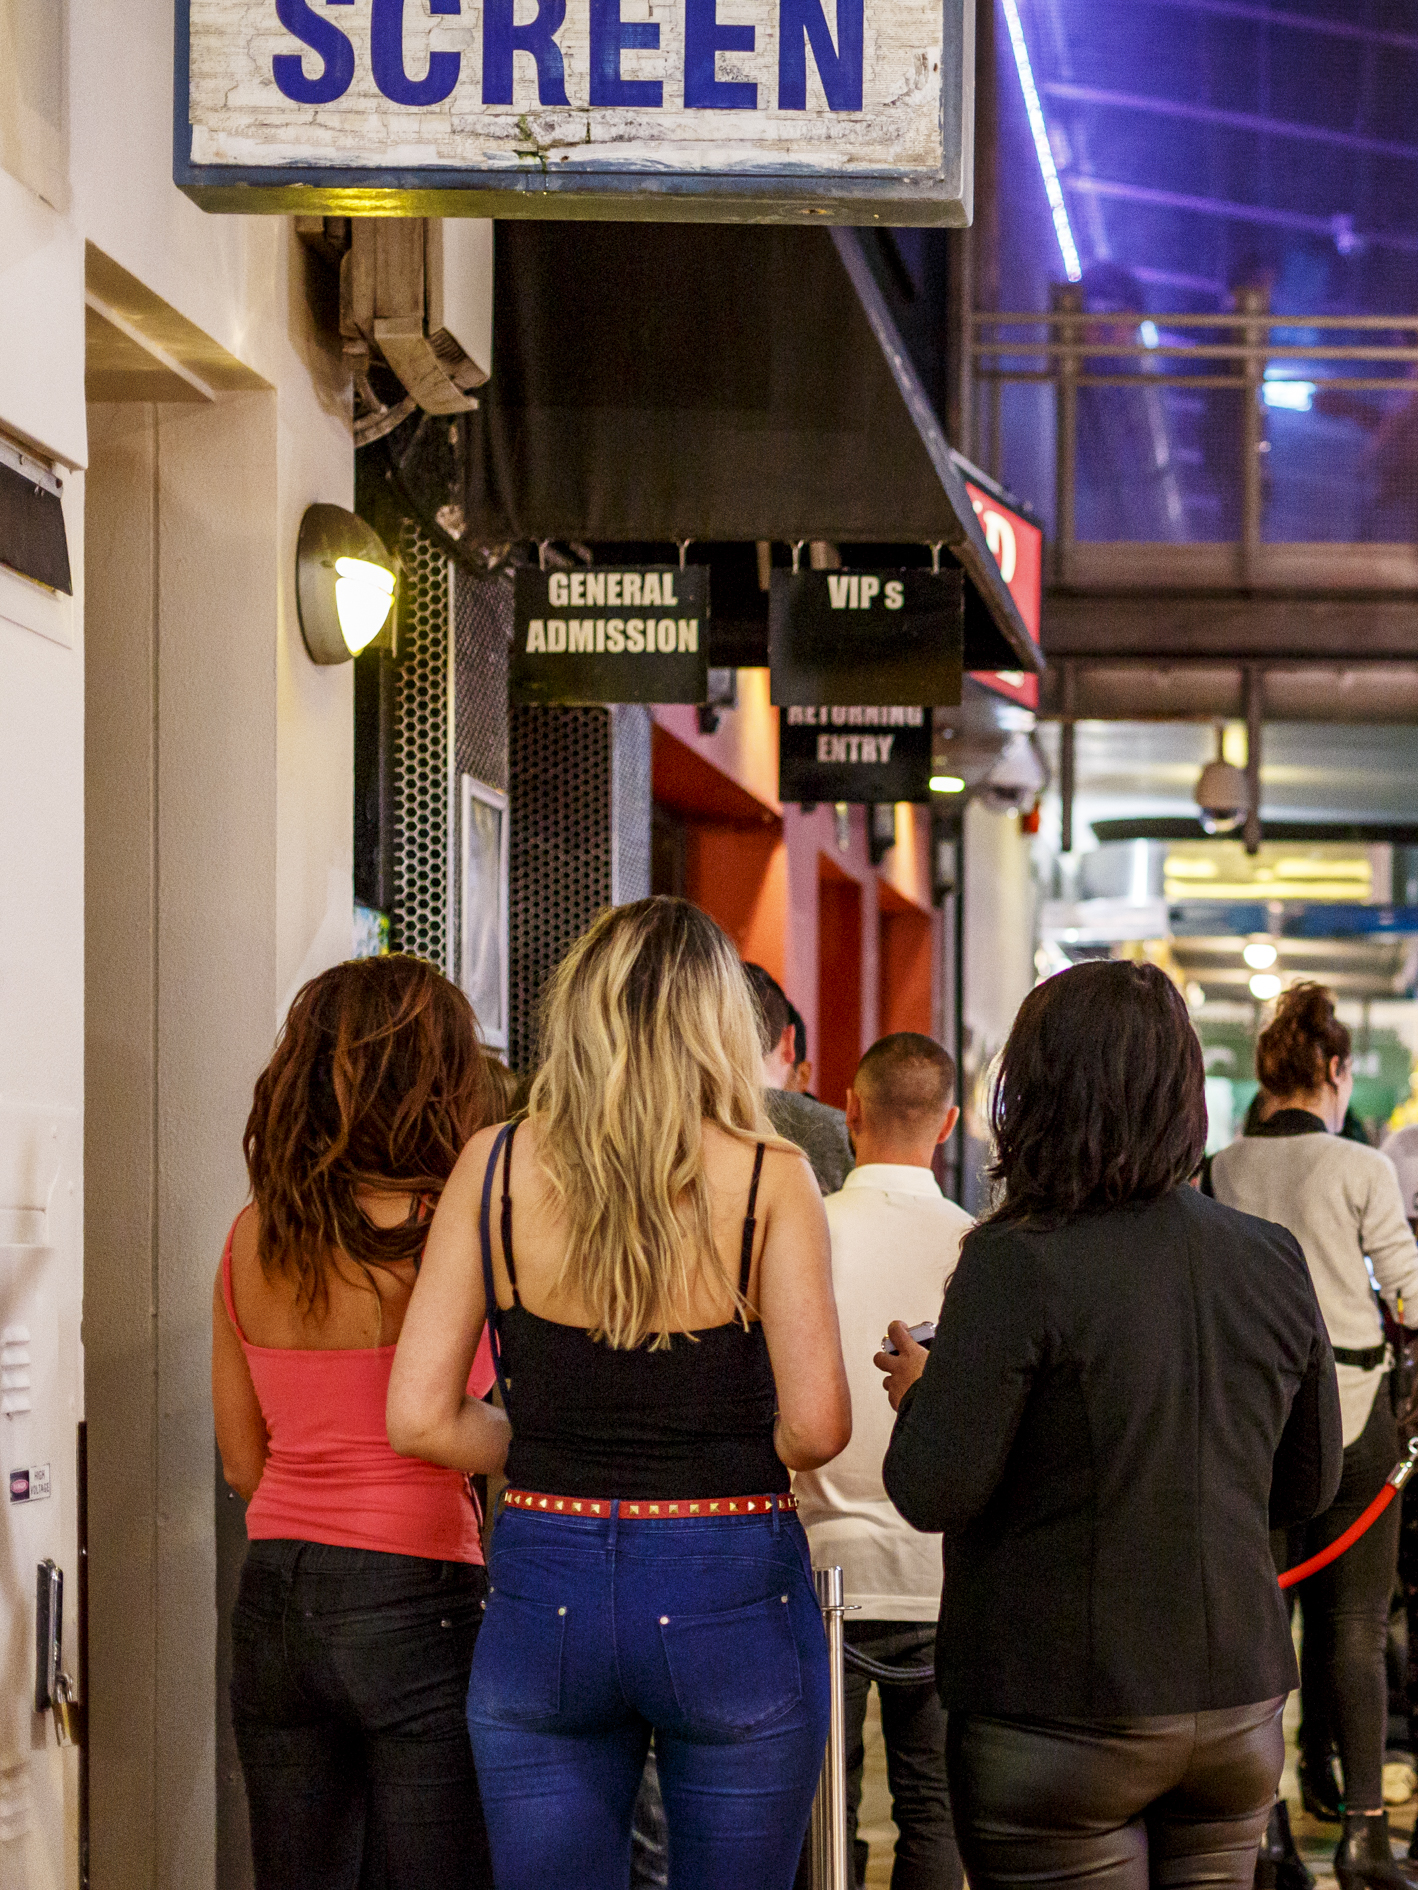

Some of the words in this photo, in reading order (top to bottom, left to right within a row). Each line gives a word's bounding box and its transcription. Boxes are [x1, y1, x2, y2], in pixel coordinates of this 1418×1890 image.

[272, 0, 864, 111] SCREEN
[548, 571, 679, 608] GENERAL
[525, 618, 700, 654] ADMISSION
[817, 733, 896, 764] ENTRY
[30, 1482, 50, 1496] VOLTAGE
[34, 1470, 46, 1481] HIGH
